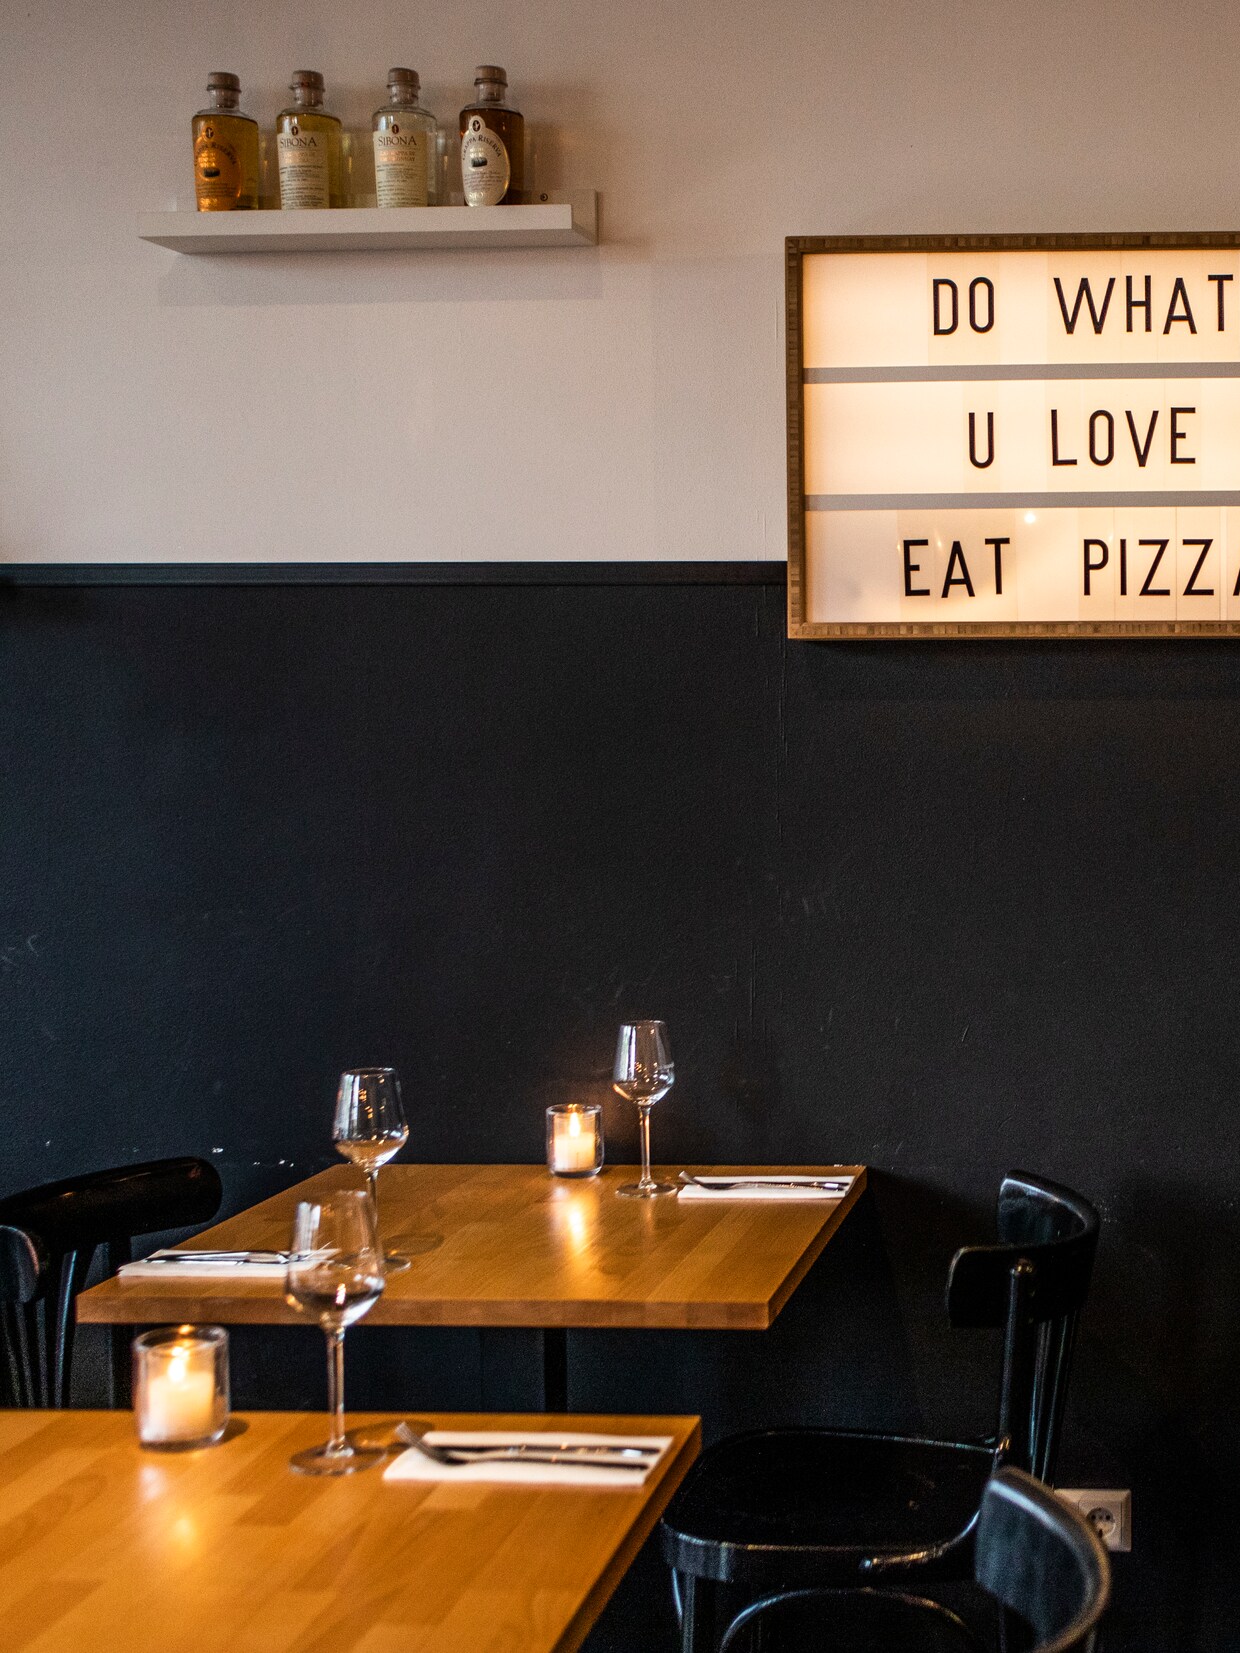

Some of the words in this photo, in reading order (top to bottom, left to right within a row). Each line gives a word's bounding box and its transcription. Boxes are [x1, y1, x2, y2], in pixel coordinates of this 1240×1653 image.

[279, 136, 318, 148] SIBONA
[377, 135, 418, 147] SIBONA
[932, 276, 995, 336] DO
[1053, 274, 1234, 335] WHAT
[968, 411, 995, 469] U
[1050, 407, 1197, 468] LOVE
[903, 537, 1011, 599] EAT
